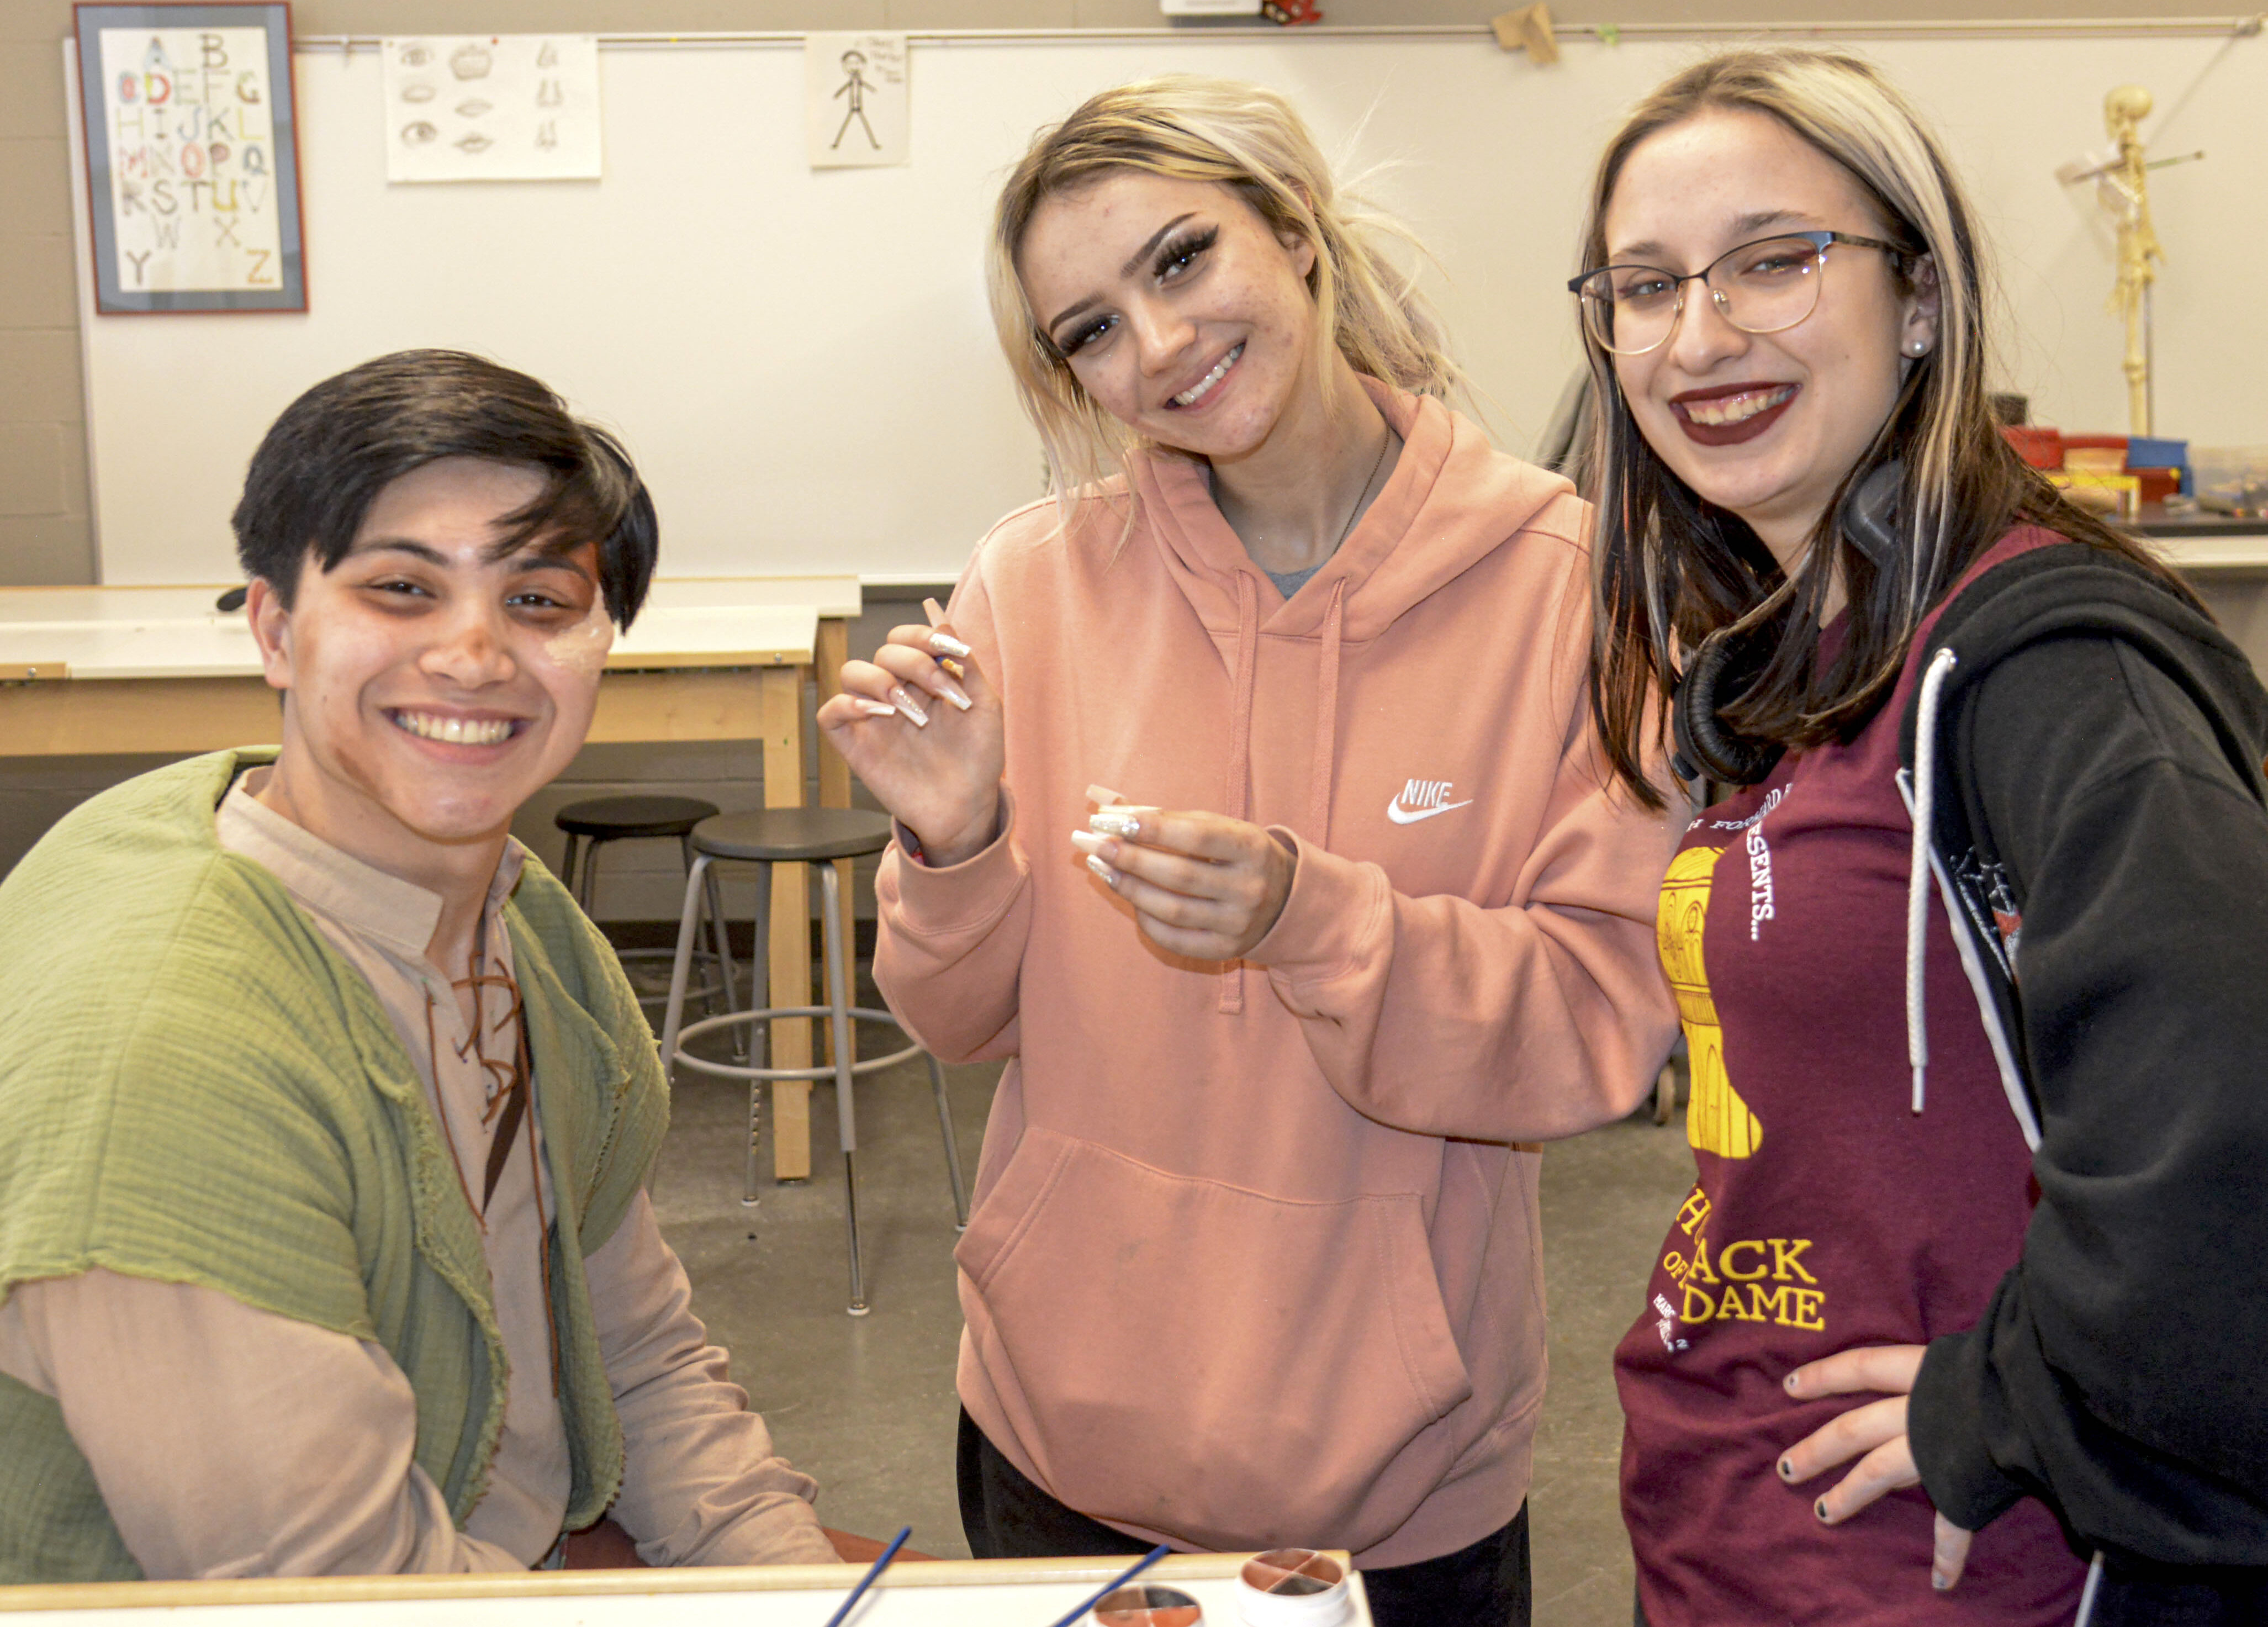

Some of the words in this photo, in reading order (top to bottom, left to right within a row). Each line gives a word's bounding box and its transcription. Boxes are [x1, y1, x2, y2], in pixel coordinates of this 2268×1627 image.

[200, 34, 228, 69] B
[145, 72, 171, 104] D
[238, 107, 265, 140] L
[151, 179, 178, 215] S
[181, 180, 211, 213] T
[211, 179, 237, 212] U
[214, 215, 241, 247] X
[126, 251, 151, 285] Y
[246, 249, 273, 284] Z
[1400, 779, 1453, 808] NIKE
[1679, 1283, 1825, 1331] DAME
